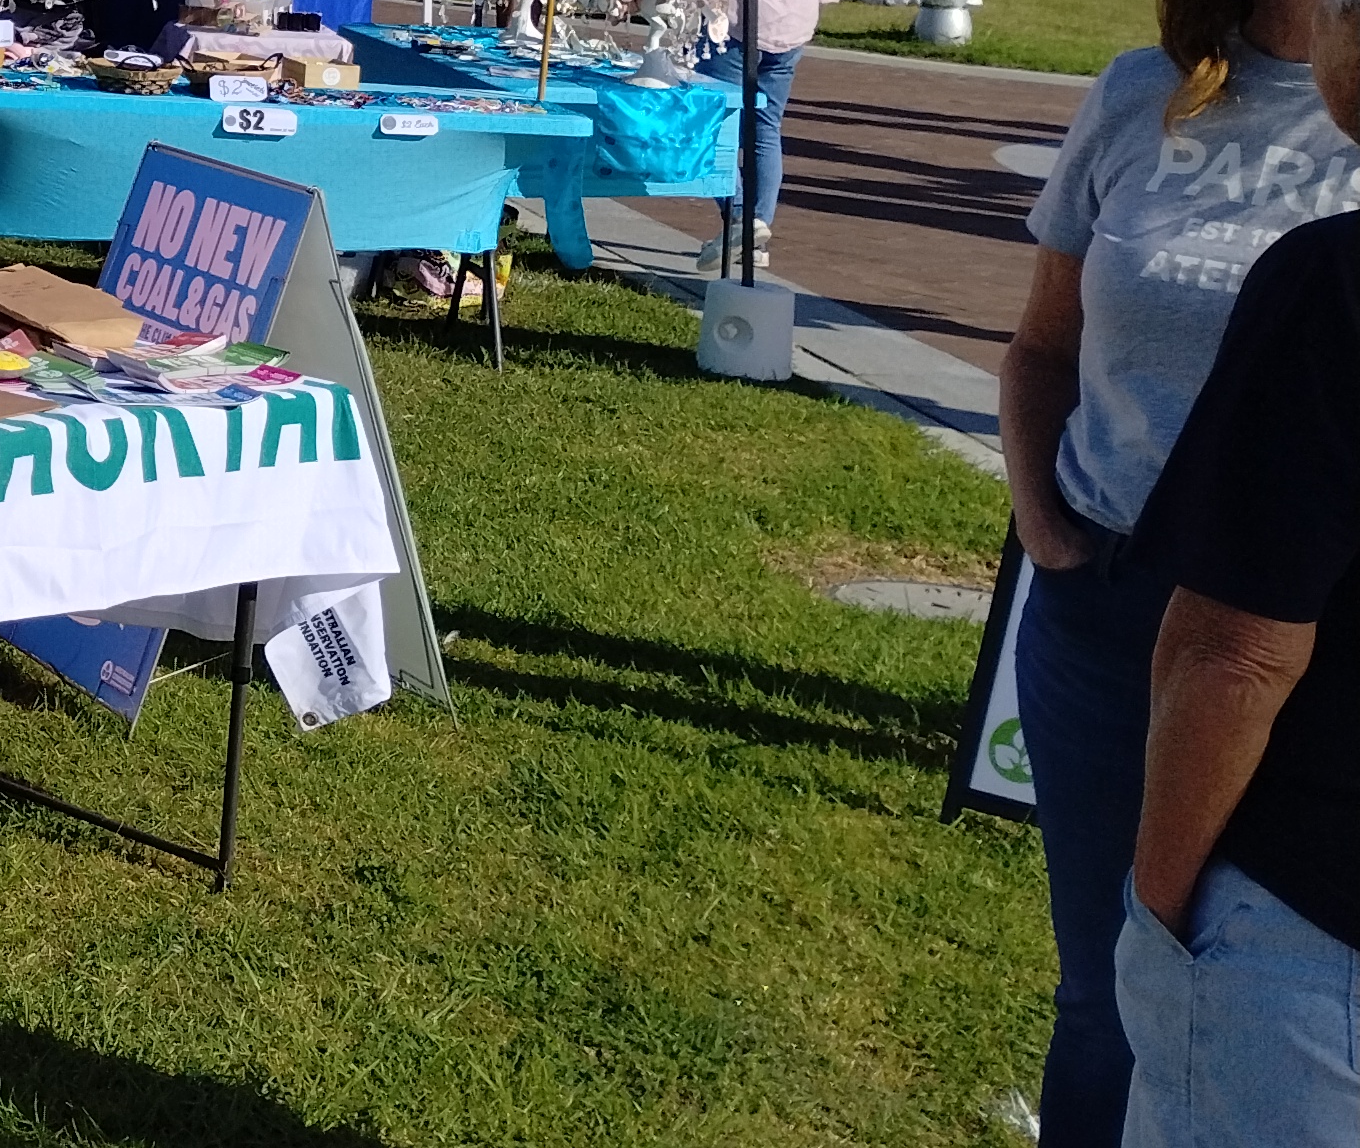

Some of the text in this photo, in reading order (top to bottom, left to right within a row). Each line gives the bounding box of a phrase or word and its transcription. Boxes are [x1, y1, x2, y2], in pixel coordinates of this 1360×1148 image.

[238, 108, 265, 132] $2
[131, 180, 287, 290] NO NEW
[1183, 218, 1243, 244] EST
[297, 620, 334, 679] NDATION
[310, 613, 351, 687] SERVATION
[321, 606, 357, 666] STRALIAN
